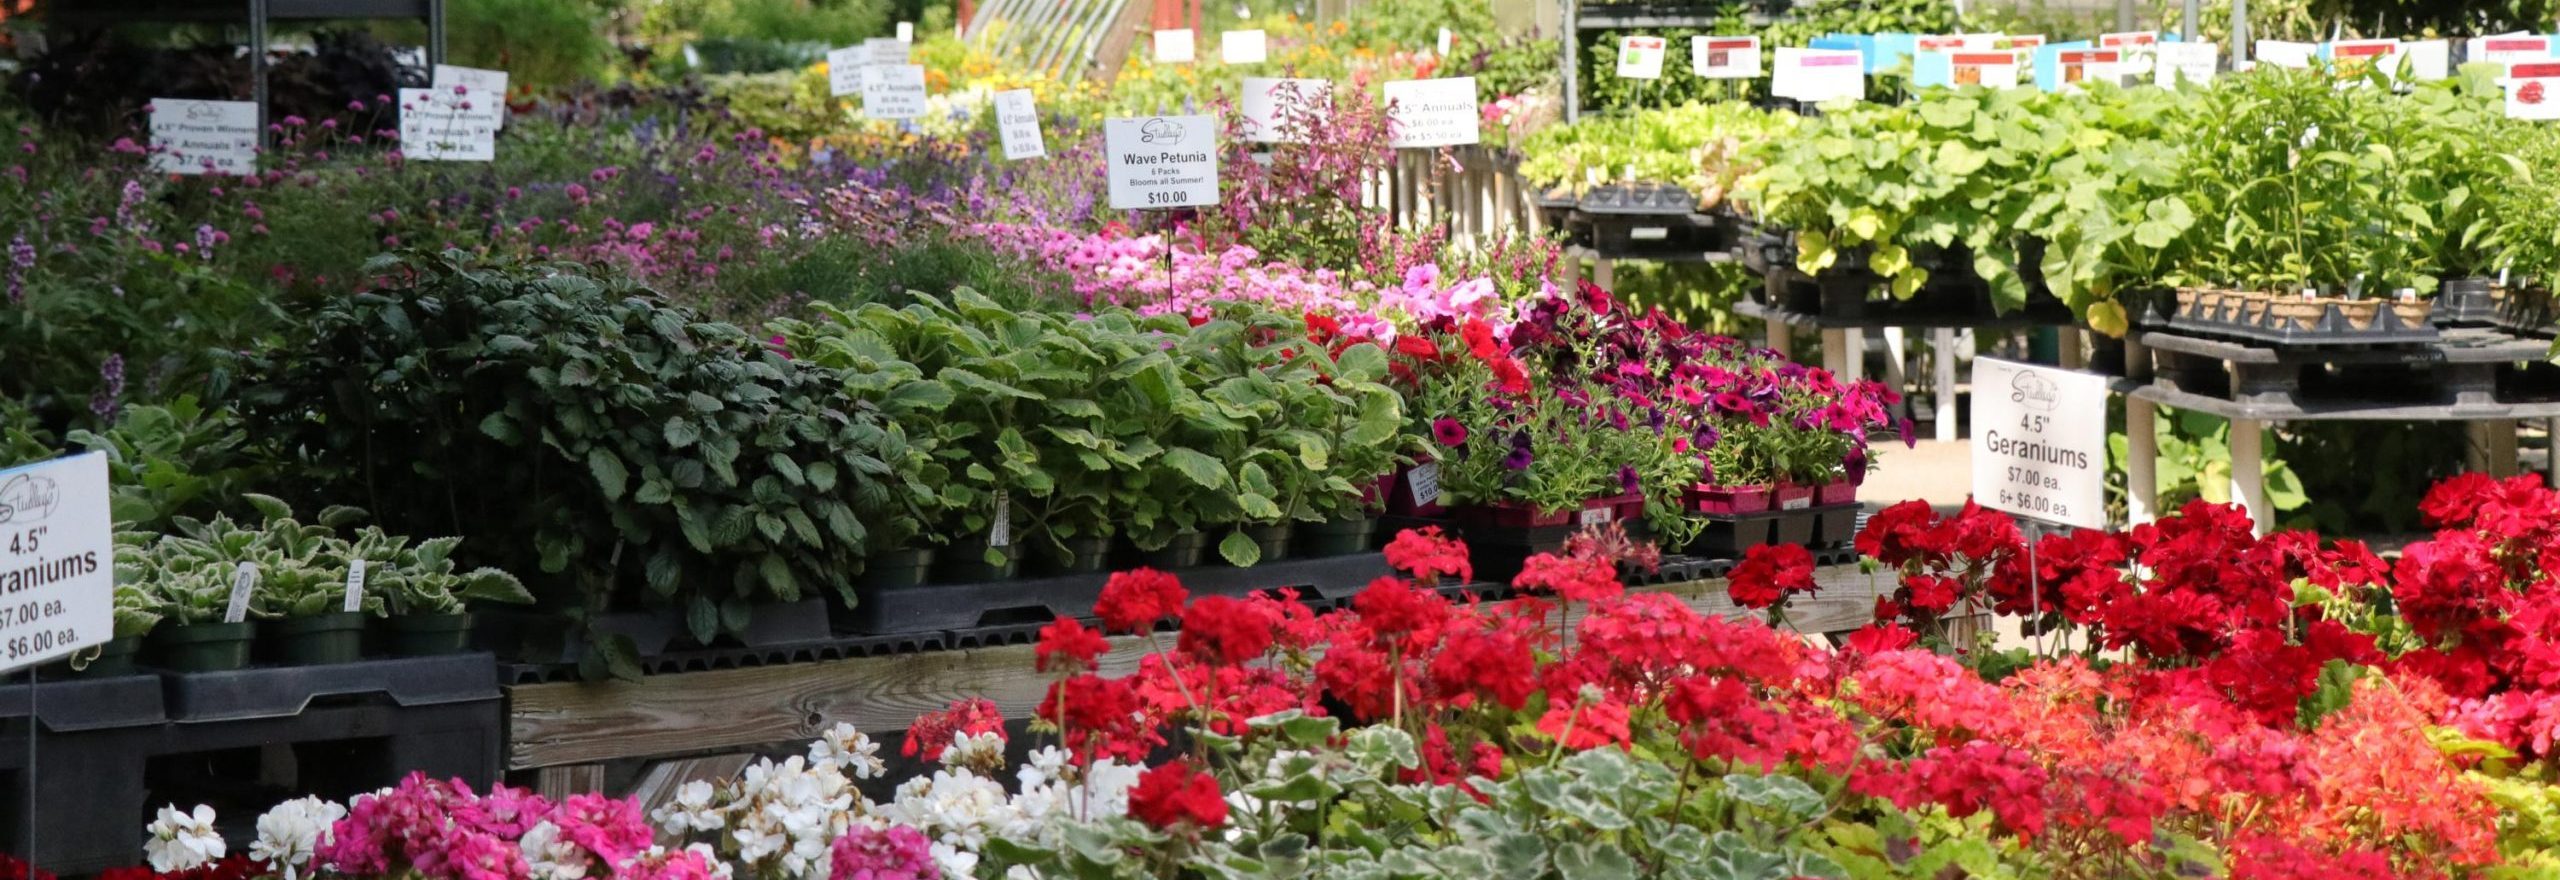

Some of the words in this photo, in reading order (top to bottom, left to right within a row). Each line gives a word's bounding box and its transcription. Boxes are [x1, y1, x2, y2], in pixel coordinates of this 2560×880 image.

[1422, 101, 1473, 113] Annuals
[182, 140, 230, 150] Annuals
[1124, 153, 1157, 165] Wave
[1161, 151, 1207, 164] Petunia
[1151, 168, 1156, 176] 6
[1158, 167, 1180, 175] Packs
[1129, 178, 1158, 187] Blooms
[1160, 177, 1169, 186] all
[1170, 176, 1204, 185] Summer!
[1148, 190, 1187, 204] $10.00
[2020, 413, 2050, 433] 4.5"
[1986, 429, 2088, 470] Geraniums
[2007, 465, 2040, 487] $7.00
[2043, 476, 2062, 491] ea.
[1420, 484, 1438, 500] $10.0
[1999, 489, 2013, 504] 6+
[2016, 492, 2049, 513] $6.00
[2053, 502, 2071, 517] ea.
[9, 525, 48, 555] 4.5"
[0, 550, 98, 596] raniums
[44, 599, 66, 618] ea.
[8, 629, 53, 661] $6.00
[57, 627, 79, 646] ea.
